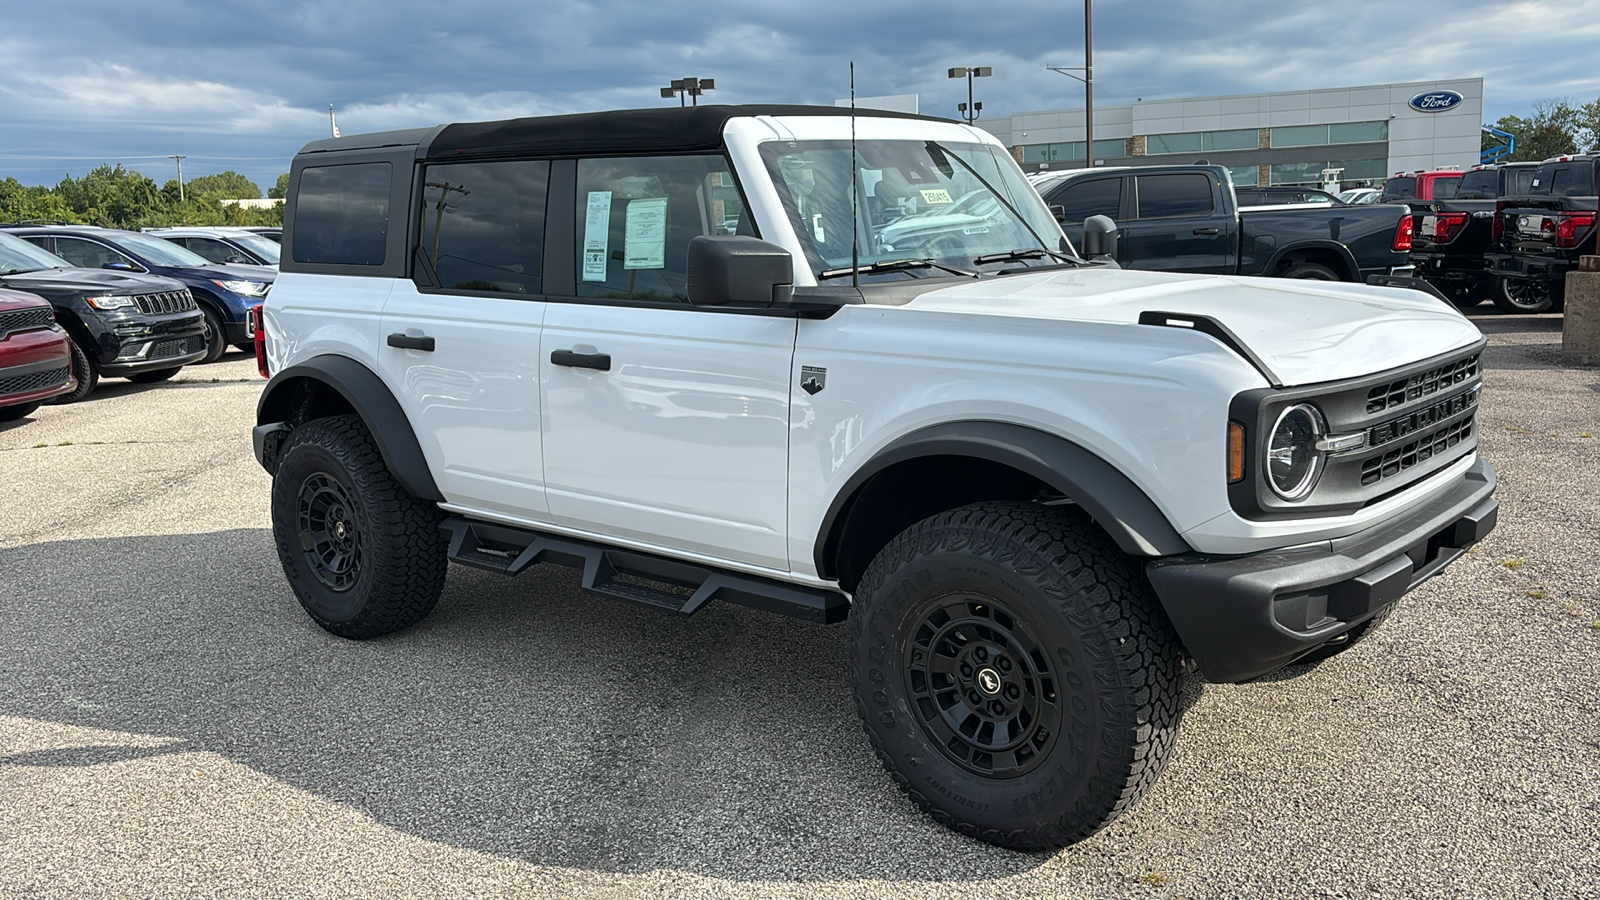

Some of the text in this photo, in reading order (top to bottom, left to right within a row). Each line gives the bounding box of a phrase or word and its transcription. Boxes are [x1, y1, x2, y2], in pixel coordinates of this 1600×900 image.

[1421, 94, 1452, 108] Ford
[1371, 391, 1478, 445] BRONCO
[923, 775, 990, 812] TERRITORY
